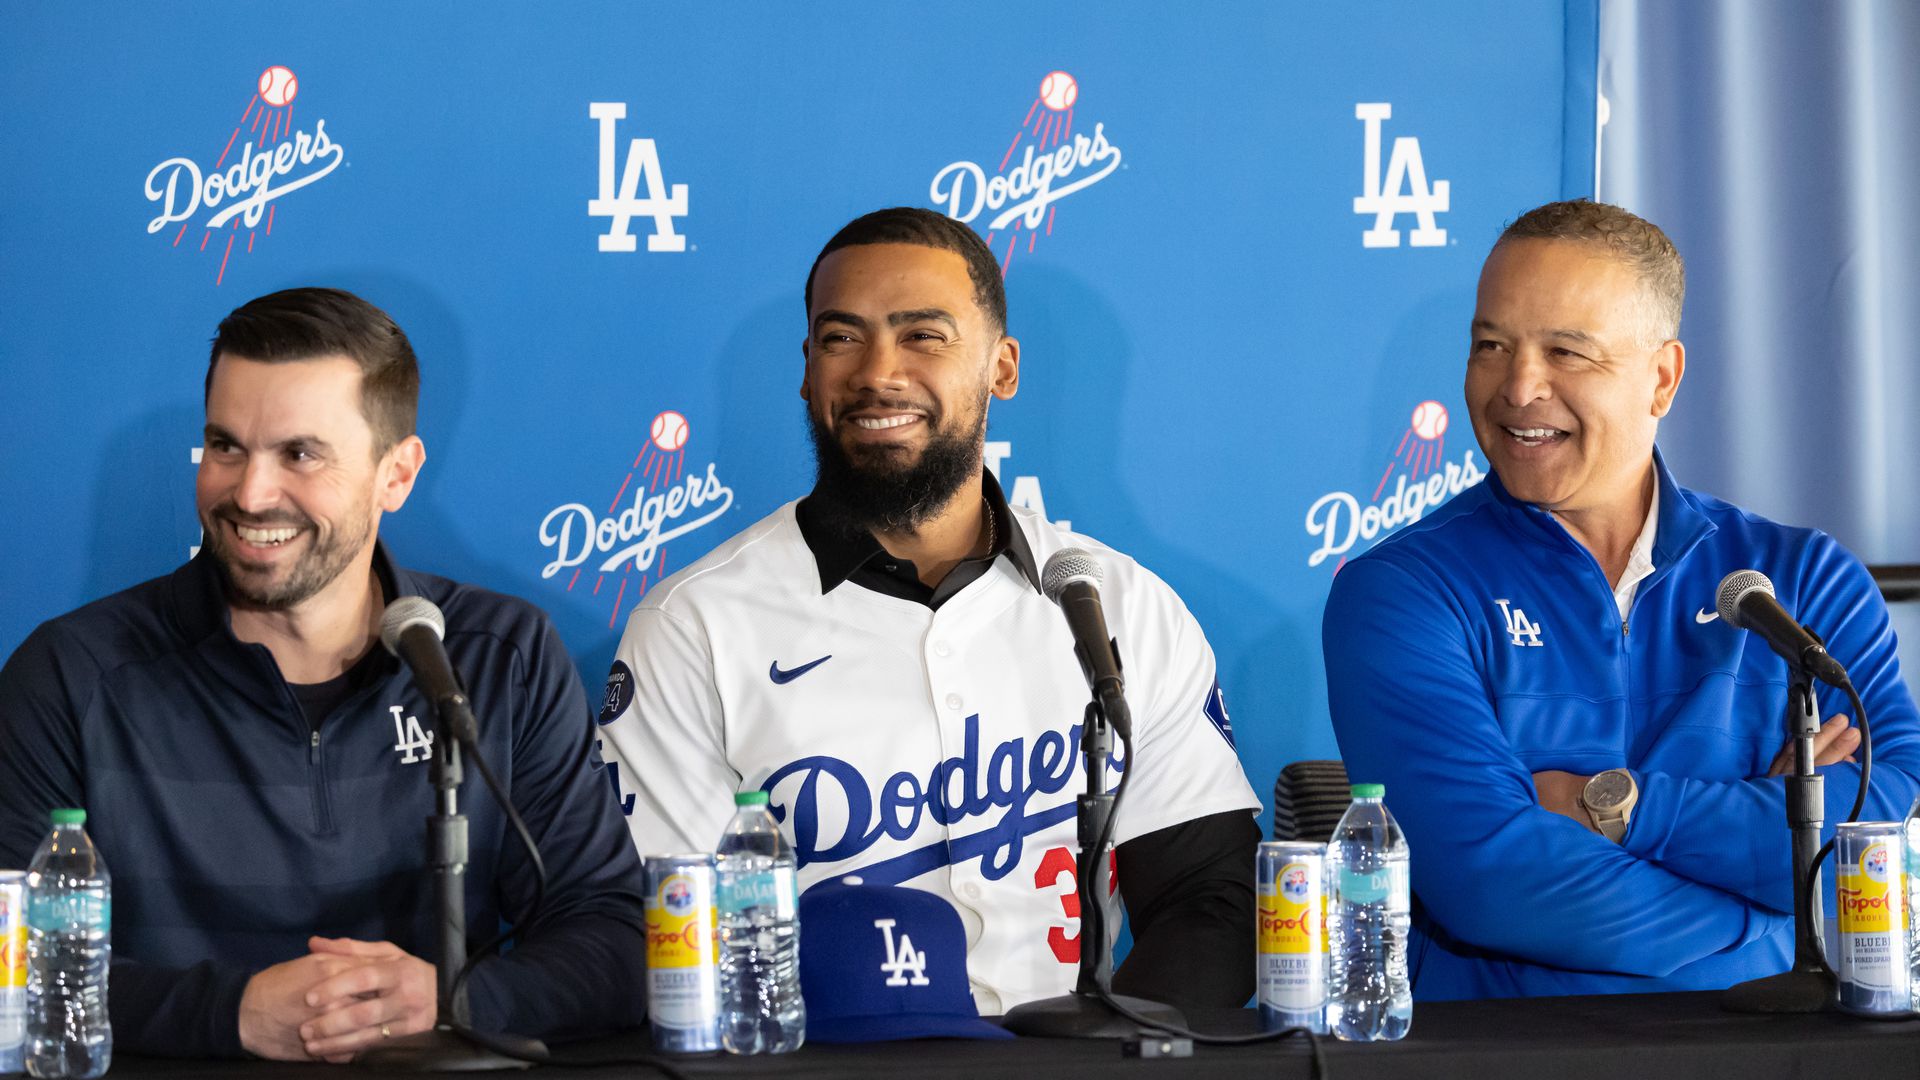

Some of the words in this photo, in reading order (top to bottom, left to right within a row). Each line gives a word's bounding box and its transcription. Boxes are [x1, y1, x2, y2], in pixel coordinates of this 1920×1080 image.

[145, 119, 343, 234] Dodgers
[588, 102, 689, 252] LA
[930, 122, 1122, 230] Dodgers
[1353, 102, 1450, 248] LA
[539, 462, 734, 579] Dodgers
[1305, 450, 1486, 567] Dodgers
[1494, 598, 1544, 647] LA
[389, 705, 435, 765] LA
[874, 919, 930, 986] LA
